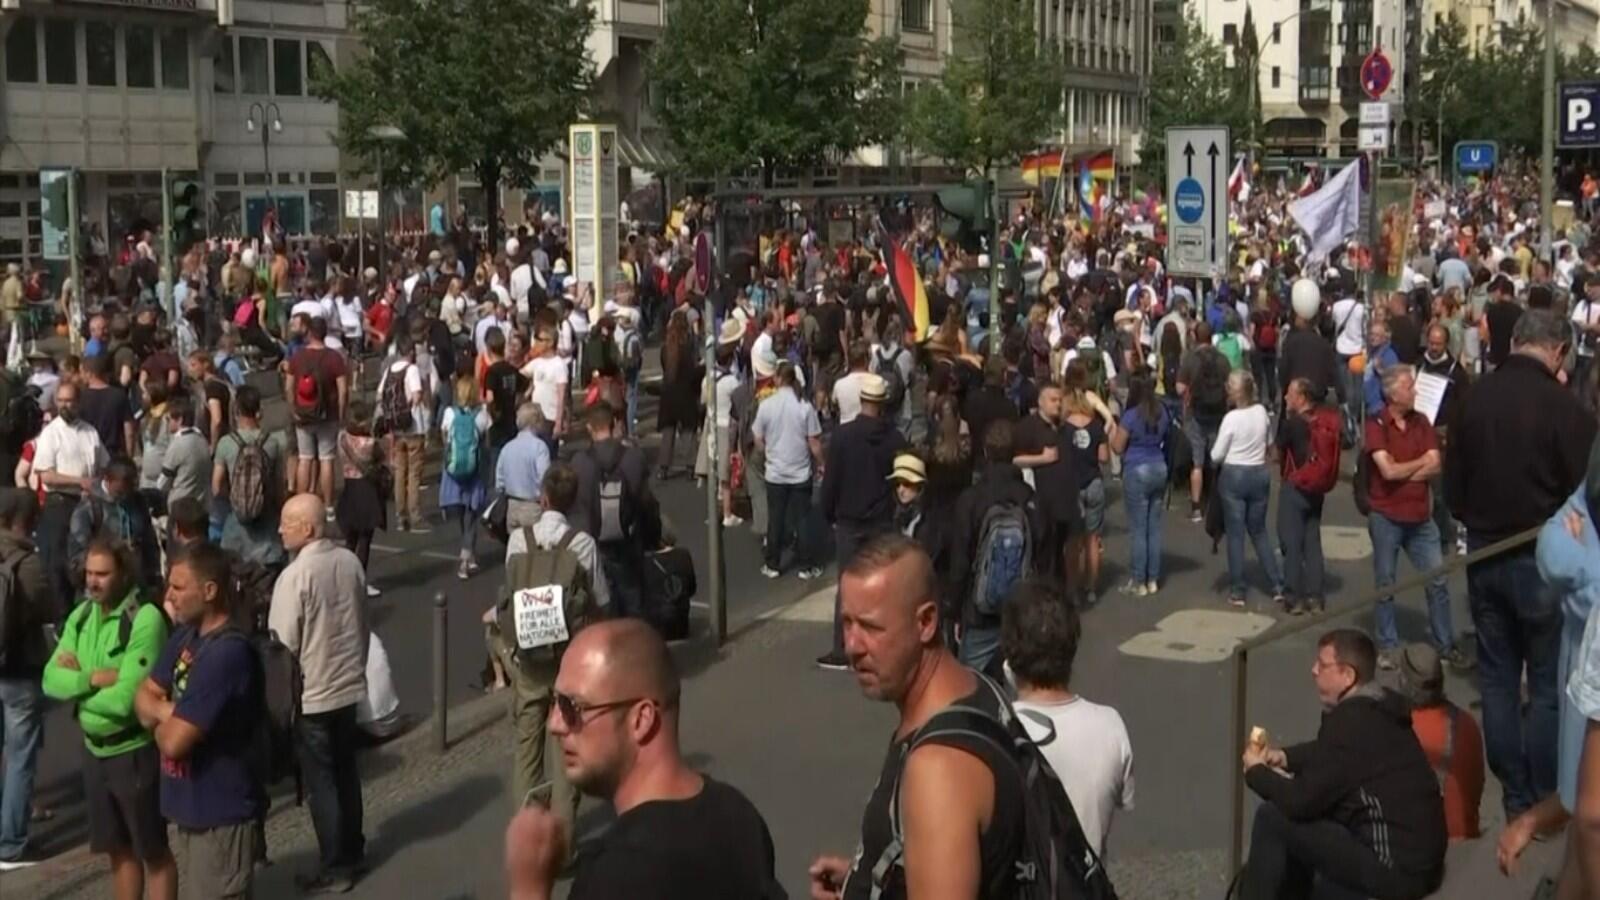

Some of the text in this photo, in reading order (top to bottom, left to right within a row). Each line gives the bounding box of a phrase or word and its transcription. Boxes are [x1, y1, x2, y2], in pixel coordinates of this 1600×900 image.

[1471, 149, 1480, 162] U
[520, 606, 558, 620] FREIHEIT
[520, 617, 560, 632] FÜR ALLE
[520, 627, 565, 641] NATIONEN
